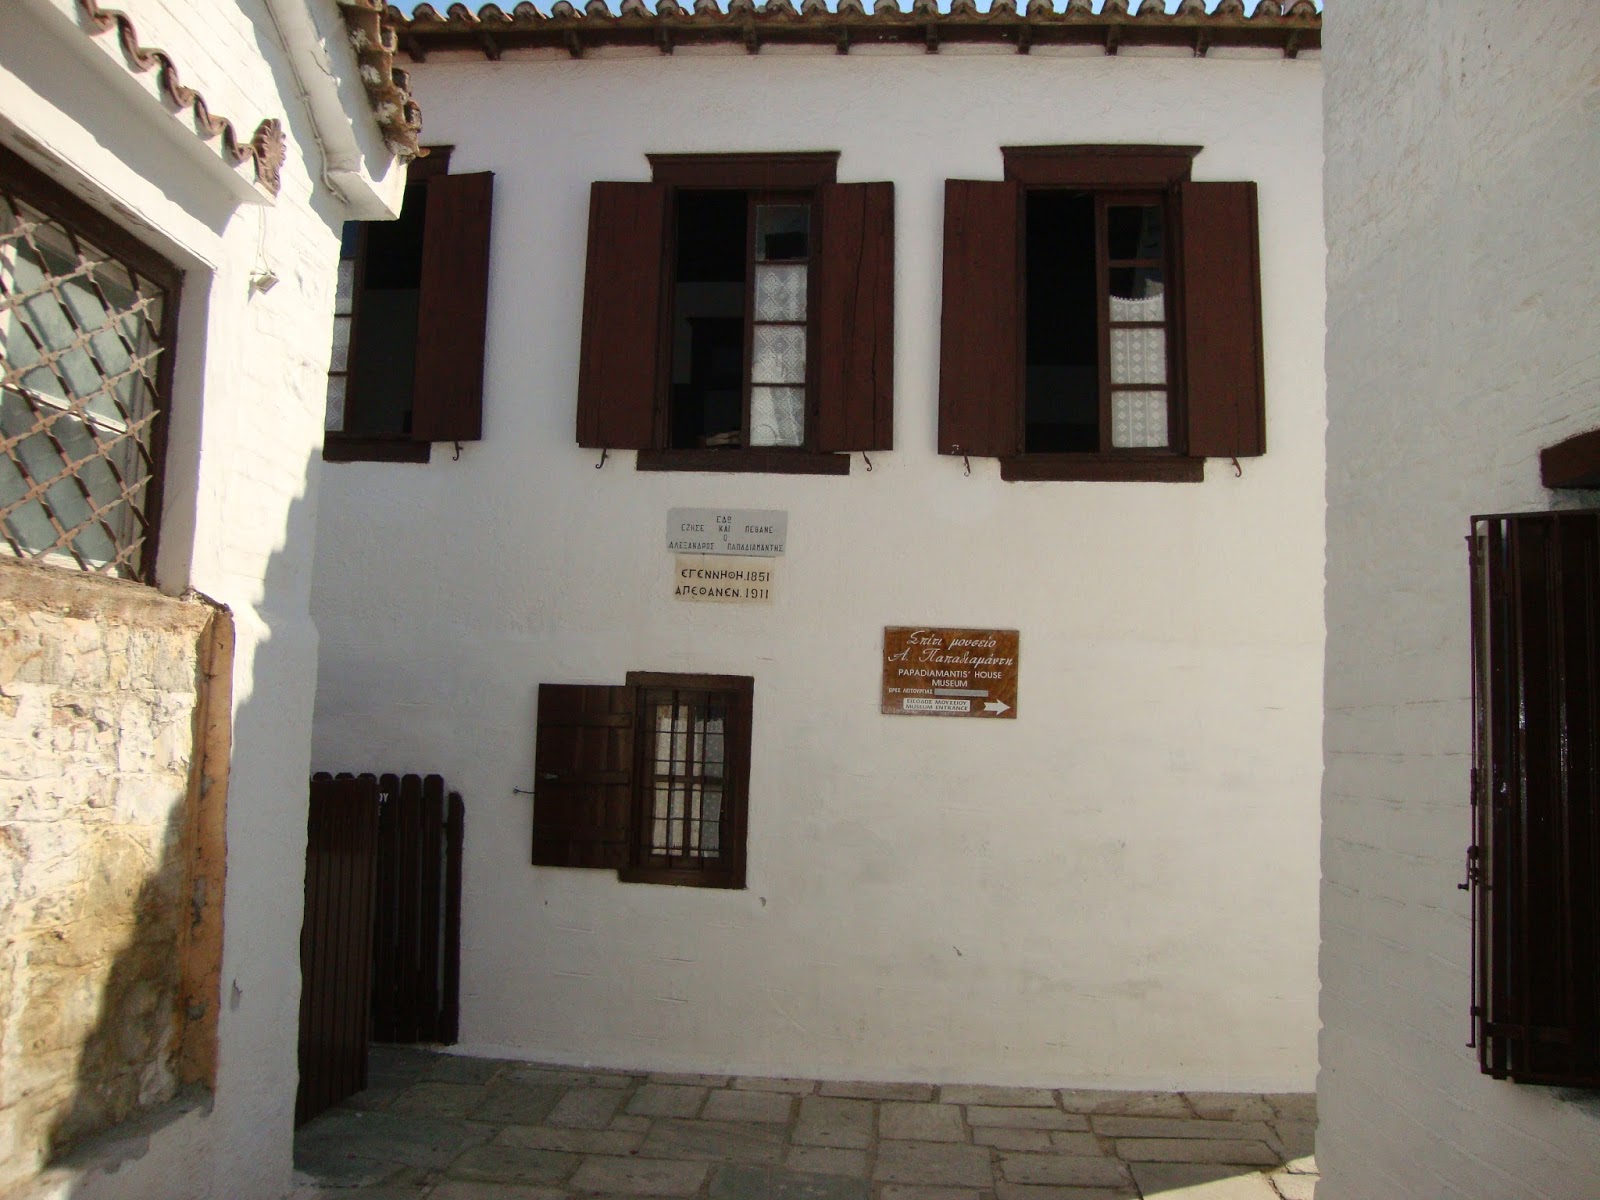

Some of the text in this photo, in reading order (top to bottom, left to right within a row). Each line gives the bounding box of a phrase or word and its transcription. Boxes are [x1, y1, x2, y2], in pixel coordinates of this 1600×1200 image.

[718, 525, 731, 533] ΚΑΙ
[745, 525, 774, 534] ΠΕΘΑΝΕ
[668, 541, 784, 552] ΑΛΕΞΑΝΔΡΟΣ ΠΑΠΑΔΙΑΜΑΝΤΗΣ
[948, 636, 997, 650] μουσείο
[919, 647, 1013, 669] Παπαδιαμάντη
[974, 671, 1002, 679] HOUSE
[931, 679, 968, 688] MUSEUM
